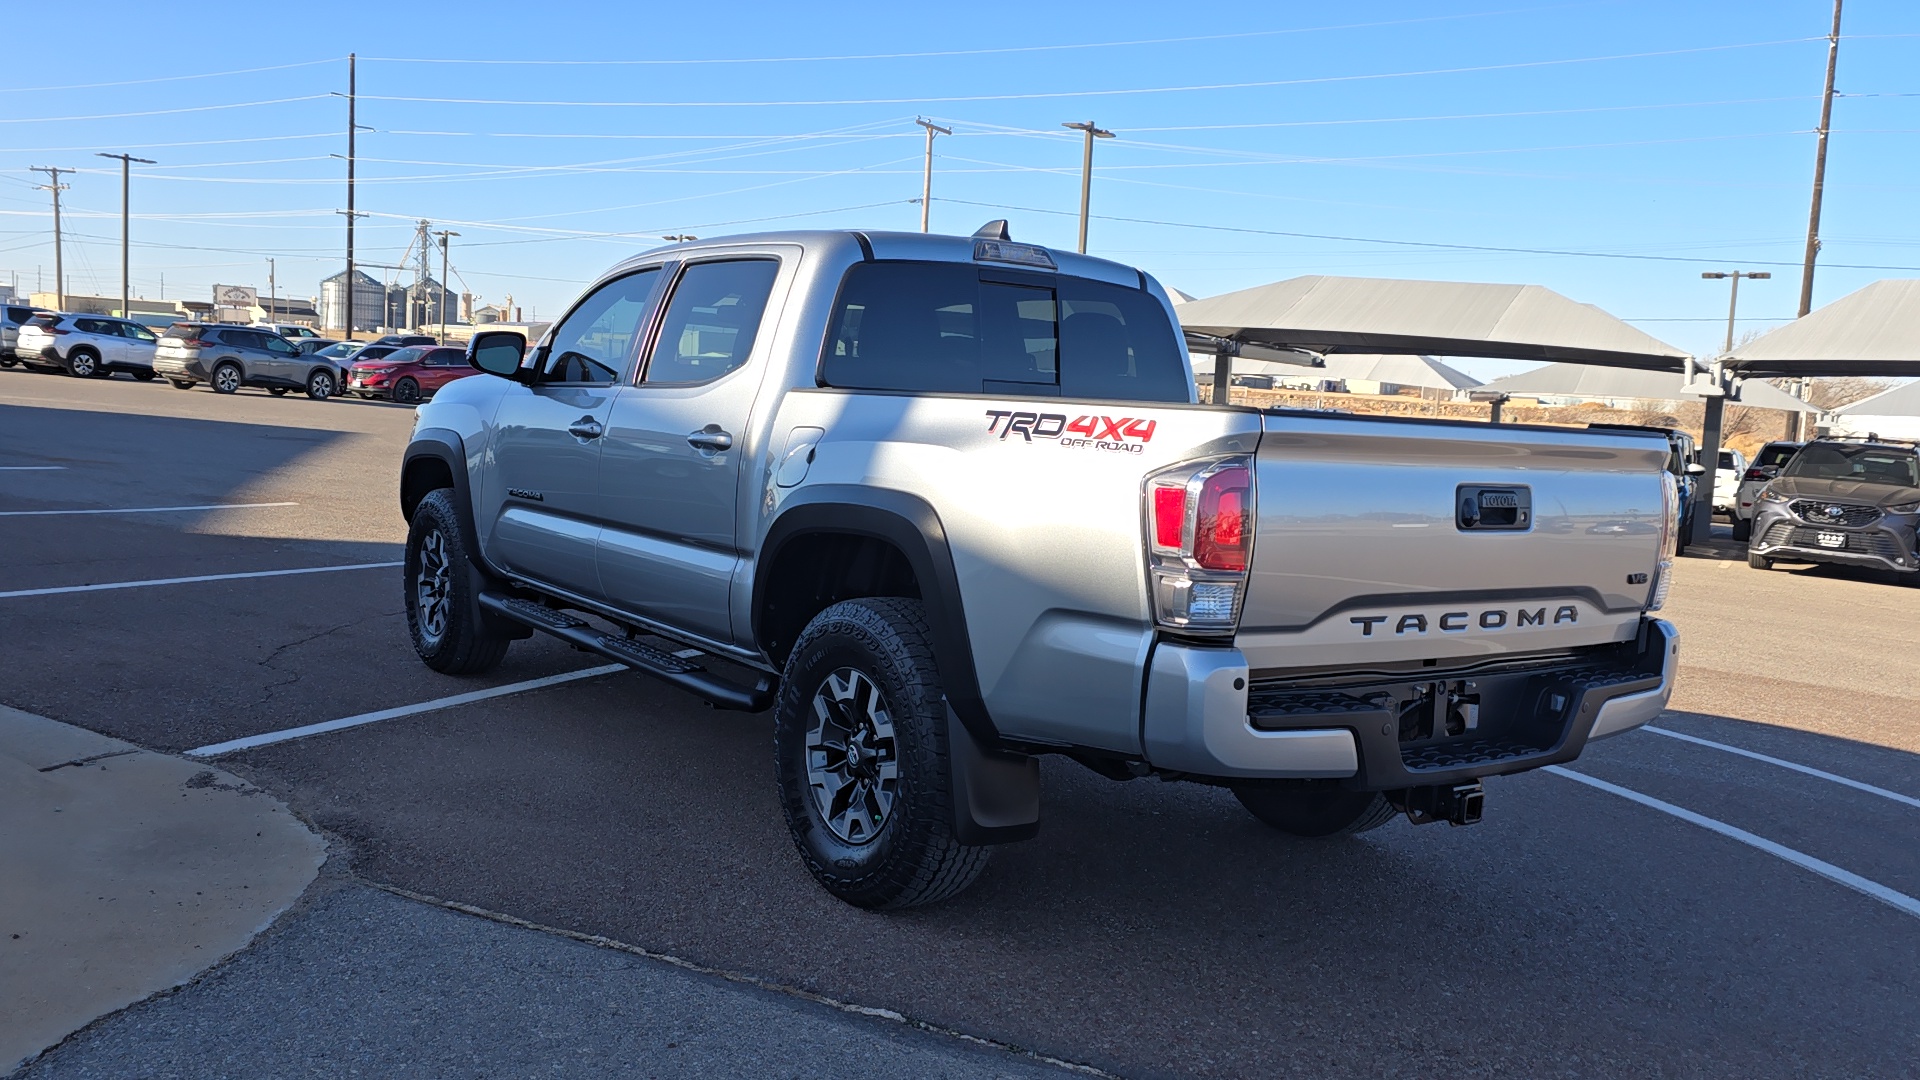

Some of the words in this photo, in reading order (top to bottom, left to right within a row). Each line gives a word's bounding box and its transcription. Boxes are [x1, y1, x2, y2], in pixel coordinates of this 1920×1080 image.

[985, 409, 1067, 444] TRD
[1060, 437, 1094, 449] OFF
[1095, 441, 1144, 454] ROAD
[1483, 495, 1518, 507] TOYOTA
[1350, 605, 1579, 636] TACOMA
